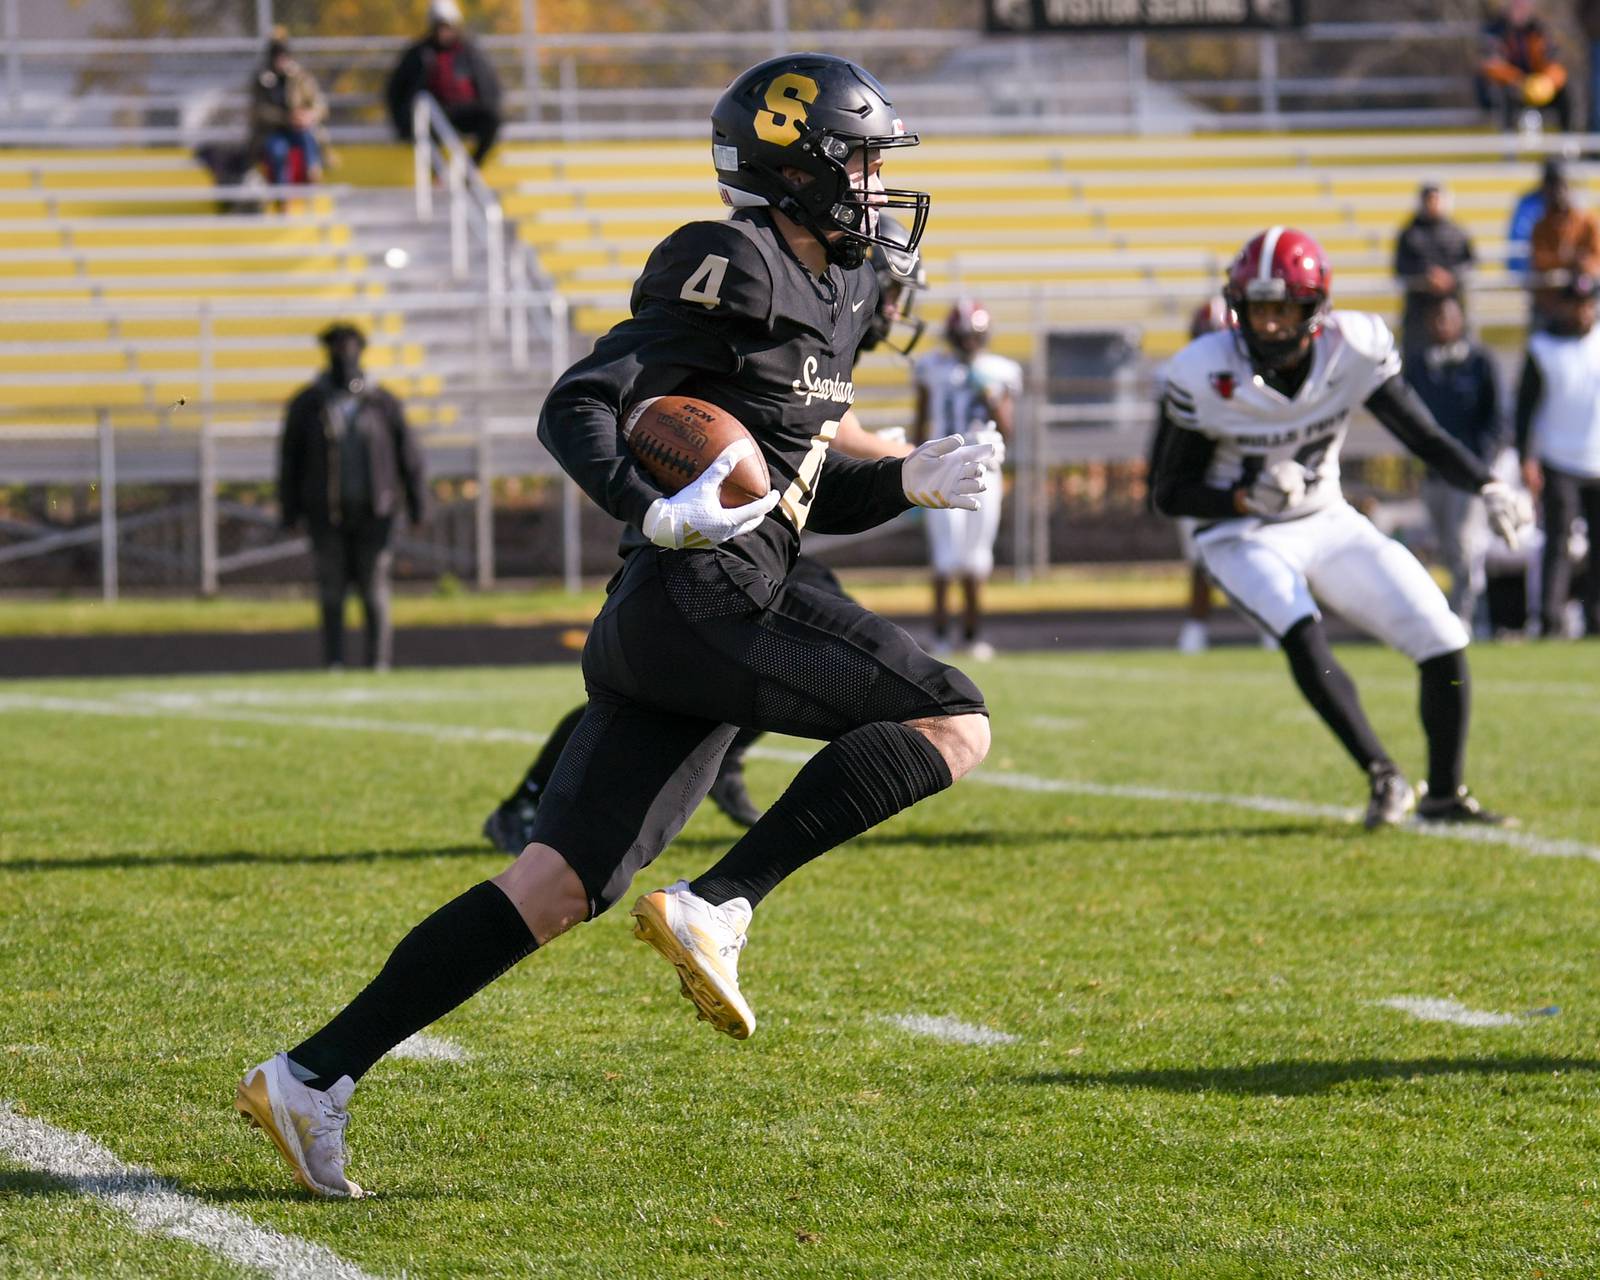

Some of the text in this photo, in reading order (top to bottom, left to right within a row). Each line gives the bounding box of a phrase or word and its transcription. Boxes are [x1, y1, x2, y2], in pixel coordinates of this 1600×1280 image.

[753, 72, 820, 147] S
[680, 253, 730, 310] 4
[682, 403, 716, 424] NCAA
